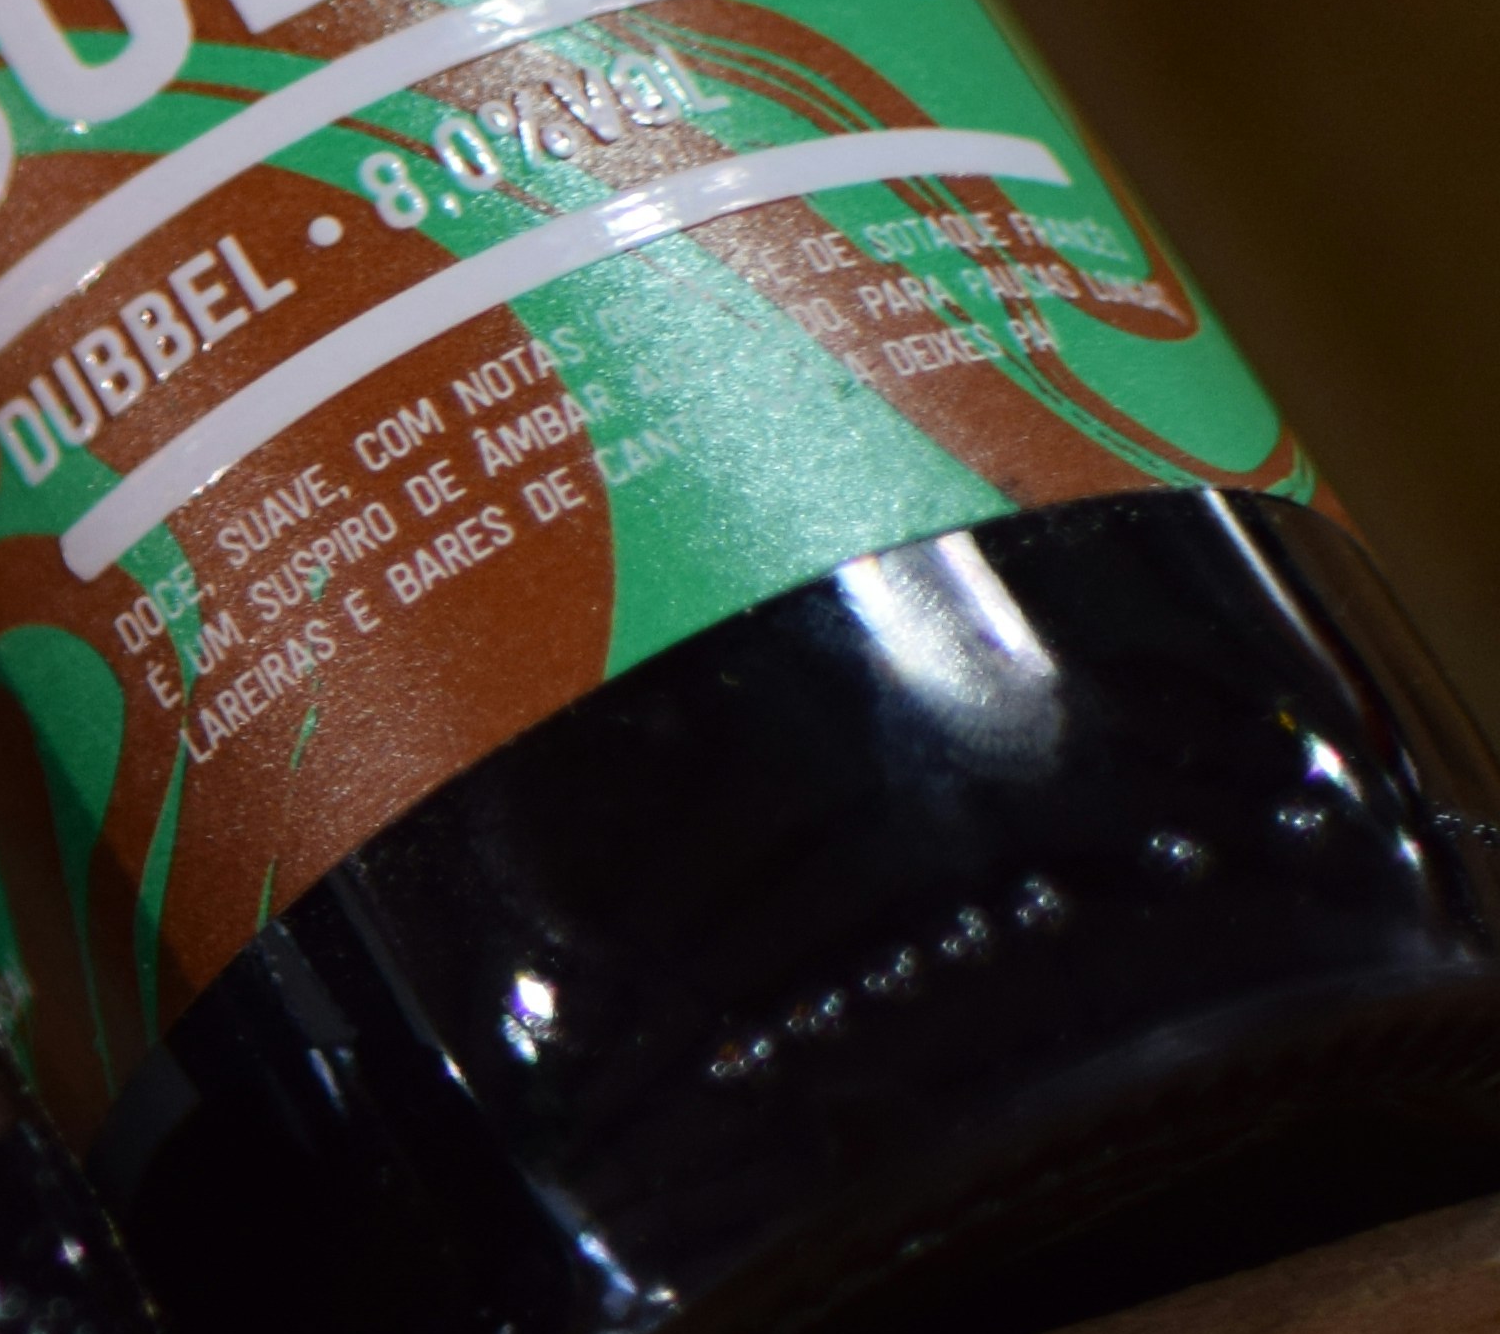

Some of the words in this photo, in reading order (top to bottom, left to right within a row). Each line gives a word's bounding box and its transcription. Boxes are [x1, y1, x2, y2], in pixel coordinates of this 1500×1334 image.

[113, 562, 217, 656] DOCE,
[216, 462, 354, 570] SUAVE,
[352, 396, 447, 473] COM
[451, 325, 589, 417] NOTAS
[799, 231, 860, 274] DE
[862, 210, 1012, 262] SOTAQUE
[180, 620, 338, 763] LAREIRAS
[343, 589, 381, 634] E
[385, 505, 516, 606] BARES
[521, 467, 588, 524] DE
[881, 323, 1005, 378] DEIXES
[186, 611, 246, 676] UM
[248, 501, 401, 624] SUSPIRO
[403, 459, 469, 518] DE
[471, 380, 615, 478] ÂMBAR
[857, 273, 957, 322] PARA
